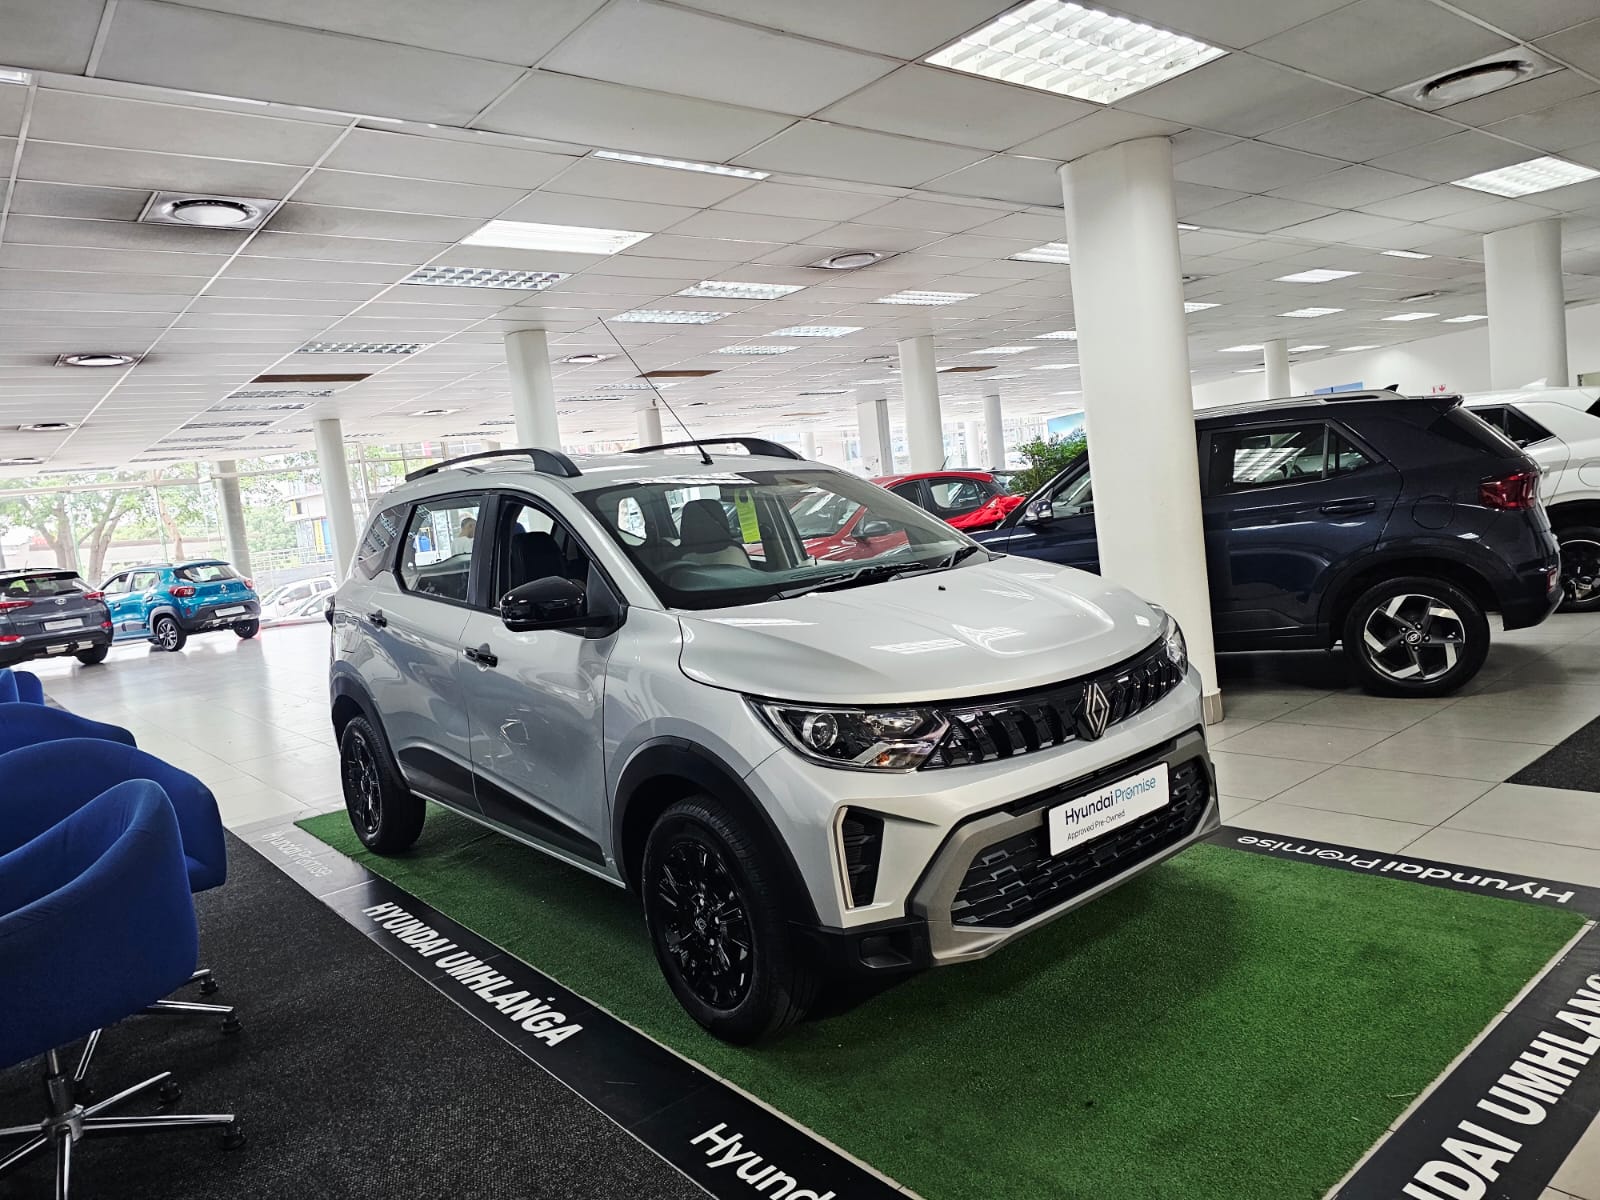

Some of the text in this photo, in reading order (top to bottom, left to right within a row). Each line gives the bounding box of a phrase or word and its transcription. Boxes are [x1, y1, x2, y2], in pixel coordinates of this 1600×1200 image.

[1065, 777, 1156, 825] Hyundai Promise
[1067, 809, 1126, 841] Approved Pre-Owned
[1237, 835, 1576, 904] Hyundai Promise
[362, 901, 459, 958] HYUNDAI
